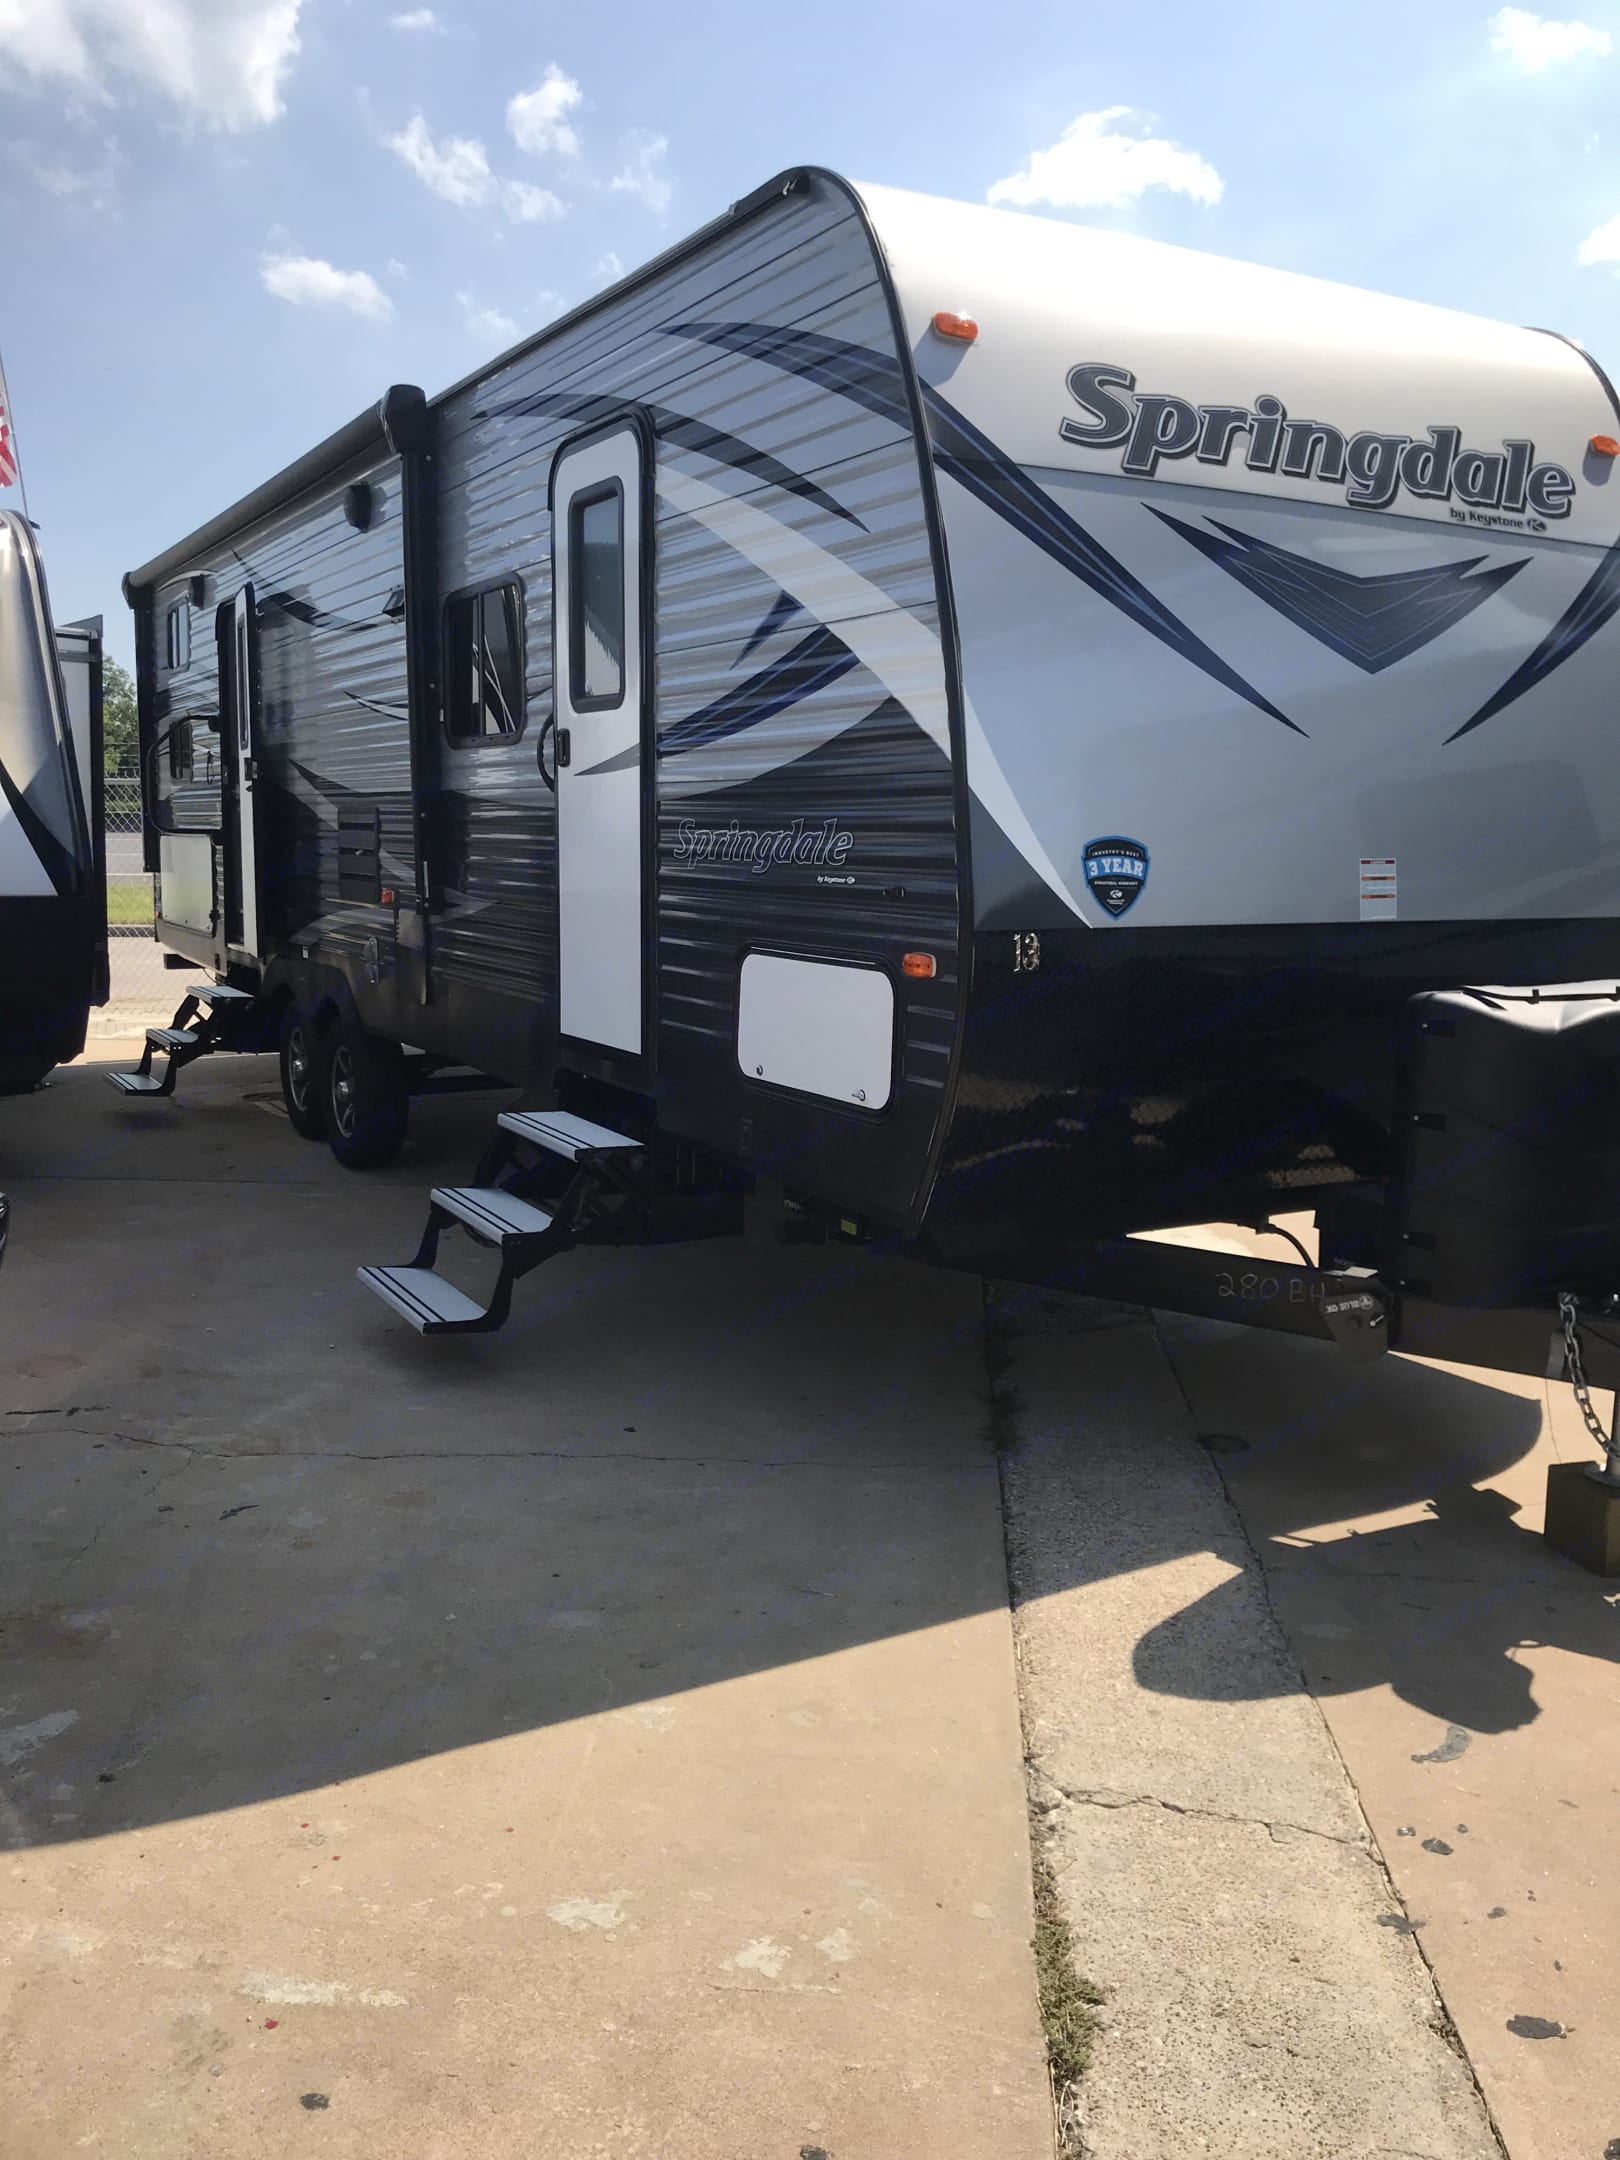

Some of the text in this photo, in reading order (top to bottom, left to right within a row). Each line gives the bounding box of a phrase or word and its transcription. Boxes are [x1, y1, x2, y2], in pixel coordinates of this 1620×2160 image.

[1058, 362, 1576, 519] Springdale
[1450, 507, 1524, 530] by Keystone
[674, 817, 854, 873] Springdale
[1089, 857, 1143, 877] 3 YEAR
[1216, 1272, 1326, 1303] 280 BH
